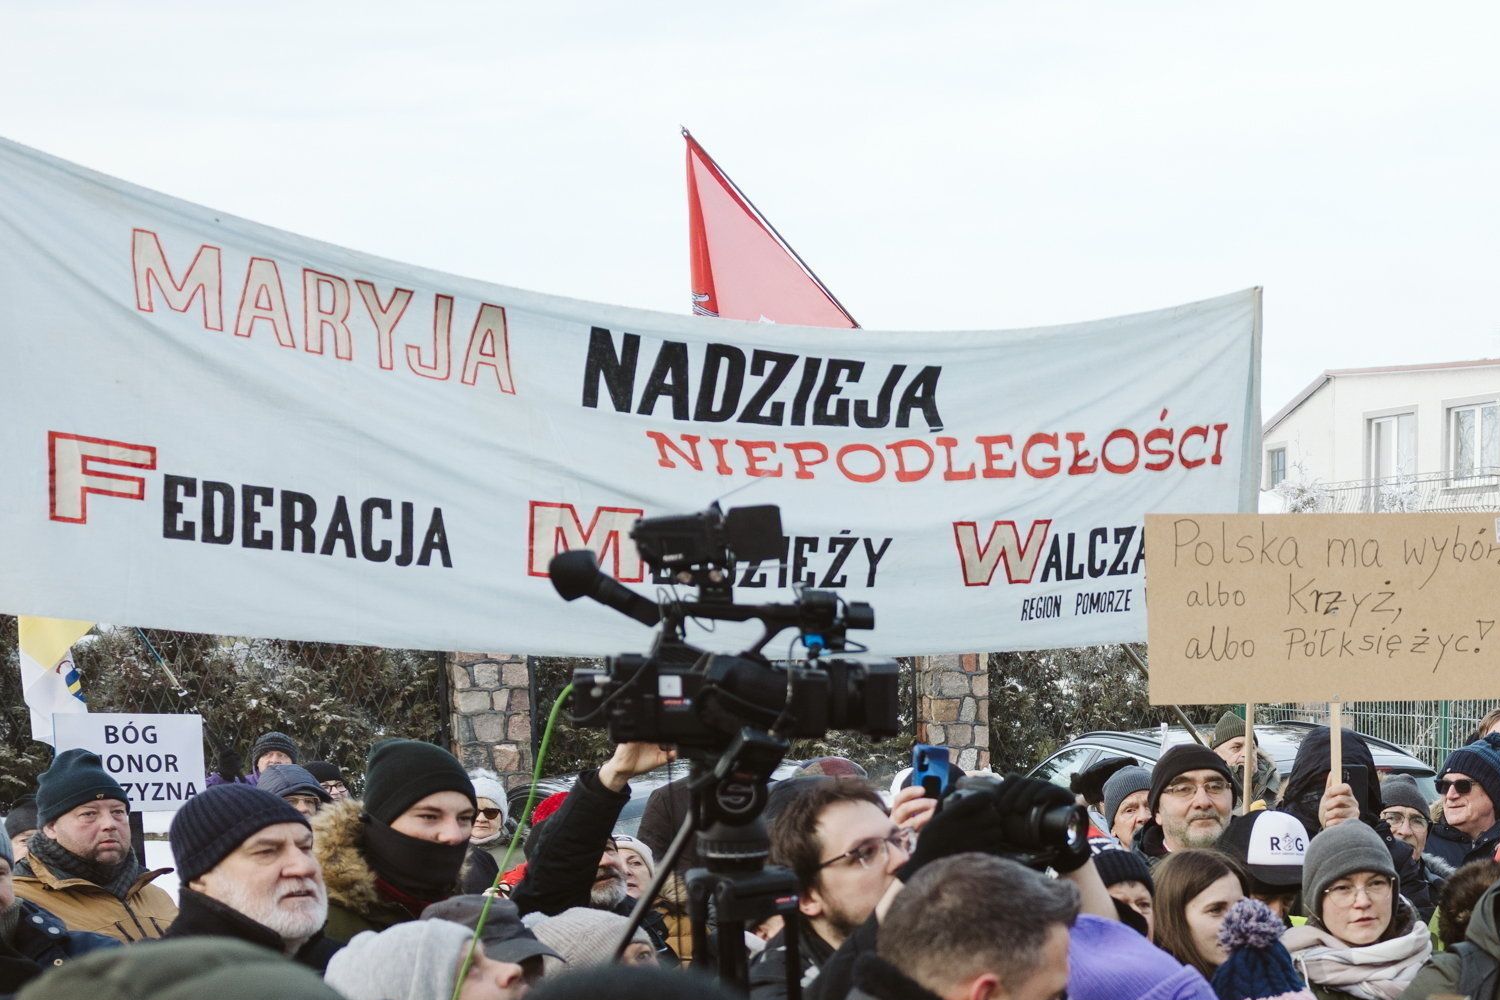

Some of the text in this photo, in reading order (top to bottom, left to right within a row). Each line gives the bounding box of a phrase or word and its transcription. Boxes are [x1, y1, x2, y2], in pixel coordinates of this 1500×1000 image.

[131, 227, 944, 432] MARYJA NADZIEJA
[646, 408, 1229, 483] NIEPODLEGŁOŚCI
[48, 430, 453, 568] FEDERACJA
[527, 500, 893, 588] MZIEŻY
[1173, 518, 1304, 568] Polska
[1326, 536, 1383, 568] ma
[1020, 594, 1062, 622] REGION
[1075, 588, 1133, 616] POMORZE
[1186, 581, 1247, 607] albo
[1184, 626, 1256, 661] albo
[104, 721, 158, 744] BÓG
[99, 754, 179, 773] ONOR
[119, 781, 198, 801] ZYZNA
